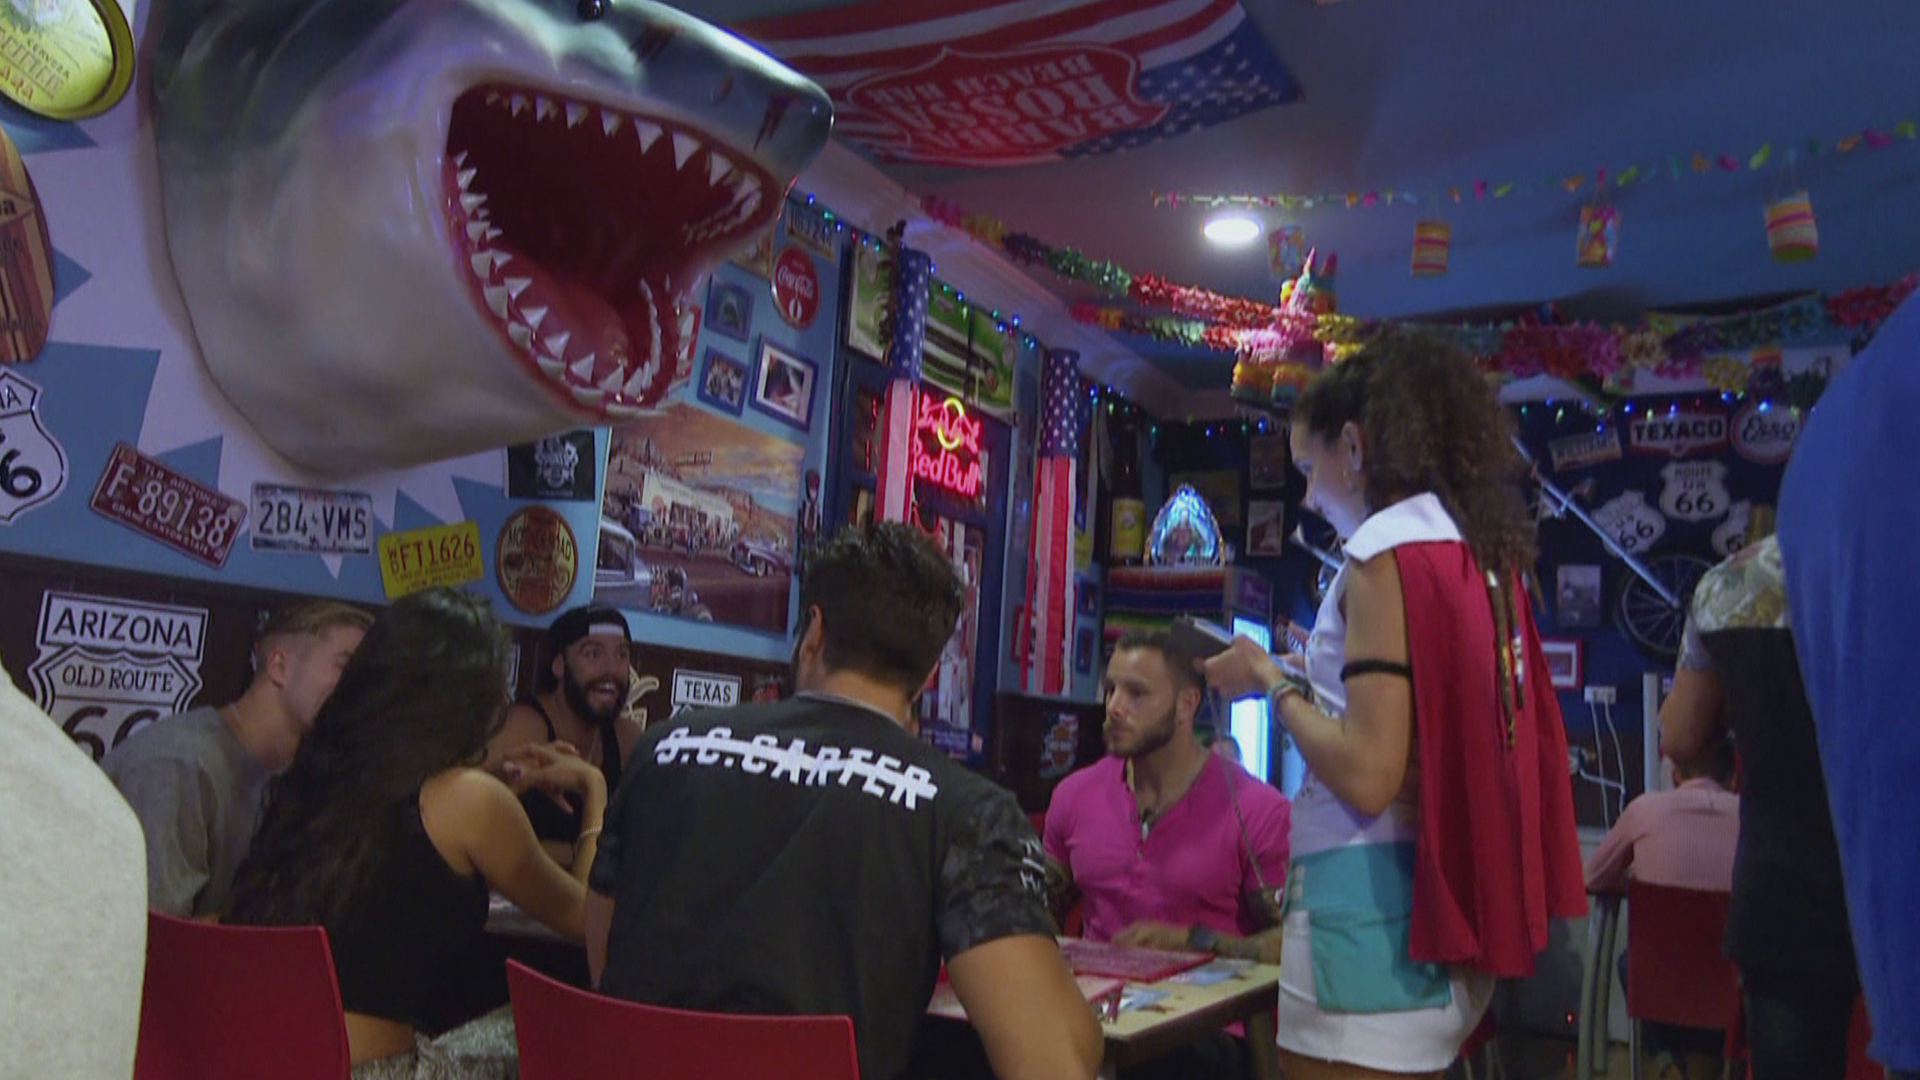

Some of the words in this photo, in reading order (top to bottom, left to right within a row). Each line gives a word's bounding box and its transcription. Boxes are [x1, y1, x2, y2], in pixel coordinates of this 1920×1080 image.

[953, 53, 1095, 96] BEACH
[883, 74, 1120, 131] ROSSA
[1633, 419, 1723, 442] TEXACO
[1742, 414, 1796, 444] Esso
[106, 461, 231, 548] F-89138
[170, 477, 219, 508] ARIZONA
[1675, 492, 1714, 514] 66
[258, 500, 308, 537] 284
[322, 505, 367, 541] VMS
[1619, 518, 1655, 549] 66
[400, 531, 475, 574] FT1626
[52, 607, 193, 649] ARIZONA
[62, 664, 106, 688] OLD
[107, 668, 174, 693] ROUTE
[684, 679, 732, 704] TEXAS
